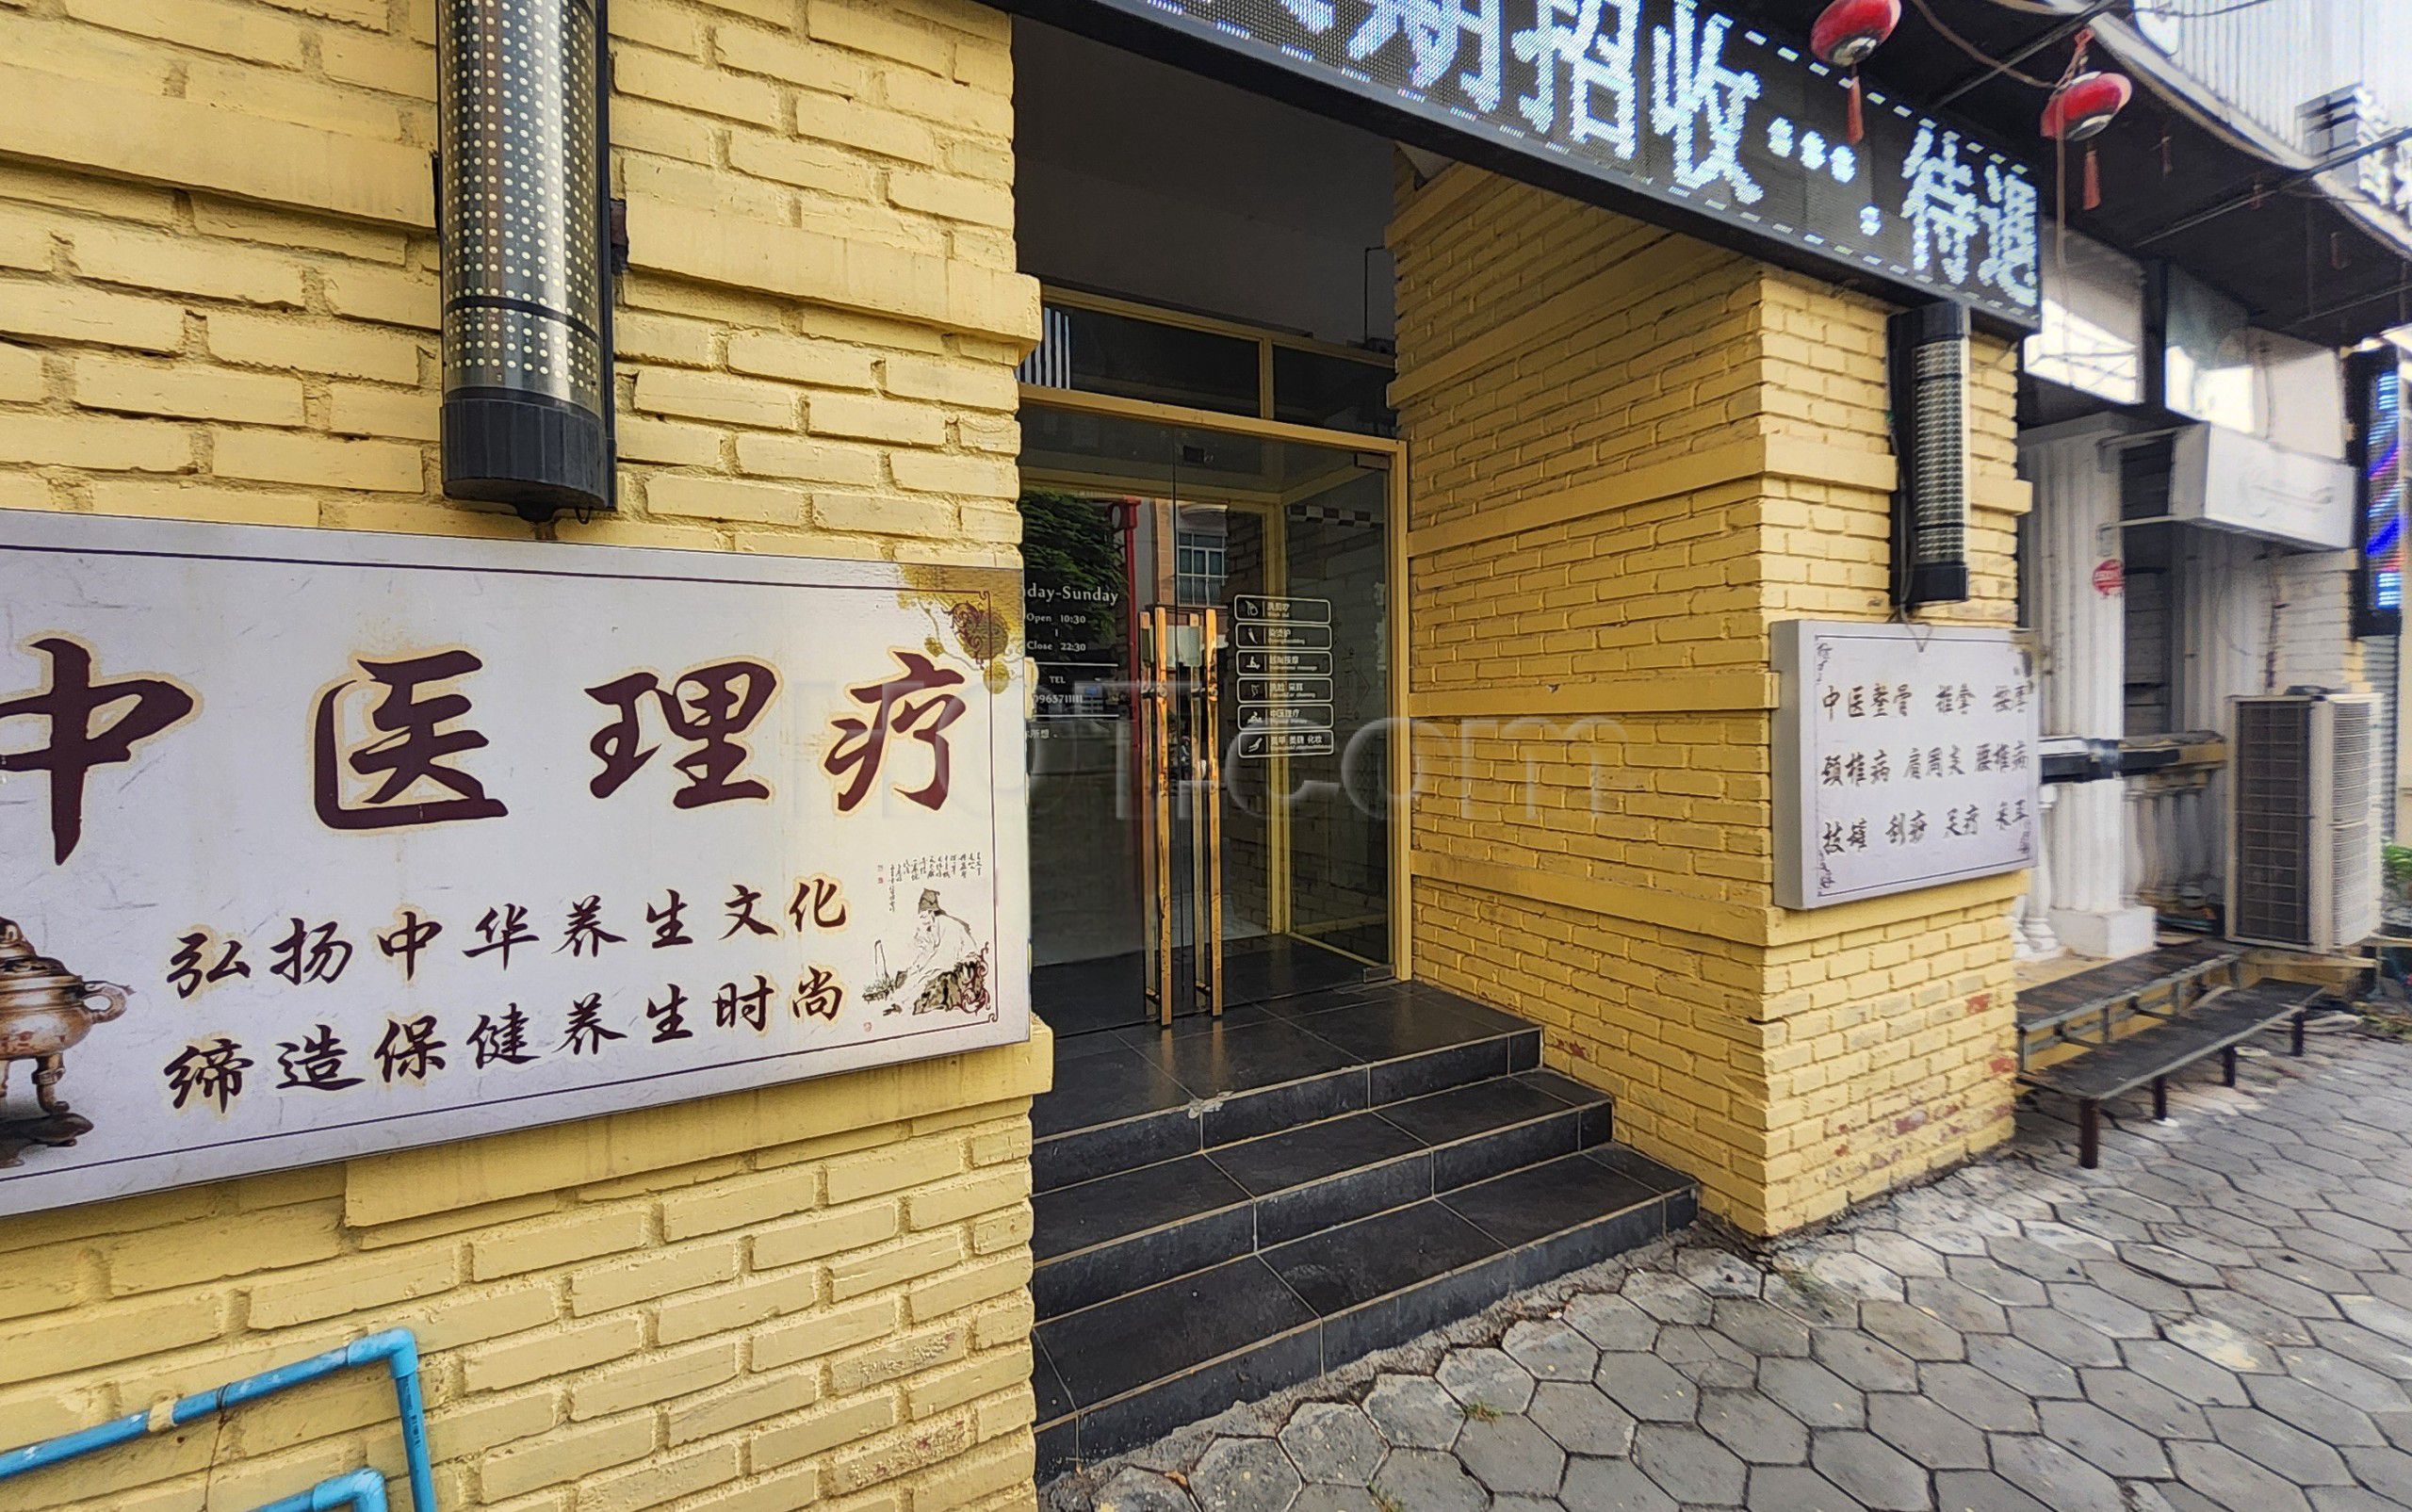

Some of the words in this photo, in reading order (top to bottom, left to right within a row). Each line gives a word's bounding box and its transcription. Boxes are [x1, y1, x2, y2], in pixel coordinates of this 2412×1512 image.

[1023, 582, 1119, 607] day-Sunday
[1026, 612, 1052, 624] Open
[1060, 614, 1086, 625] 10:30
[1026, 641, 1053, 650] Close
[1060, 642, 1086, 652] 22:30
[1049, 675, 1067, 684] TEL
[0, 638, 968, 865] 中医理疗
[1903, 744, 1965, 781] 肩周炎
[166, 878, 847, 1000] 弘扬中华养生文化
[162, 965, 844, 1114] 缔造保健养生时尚
